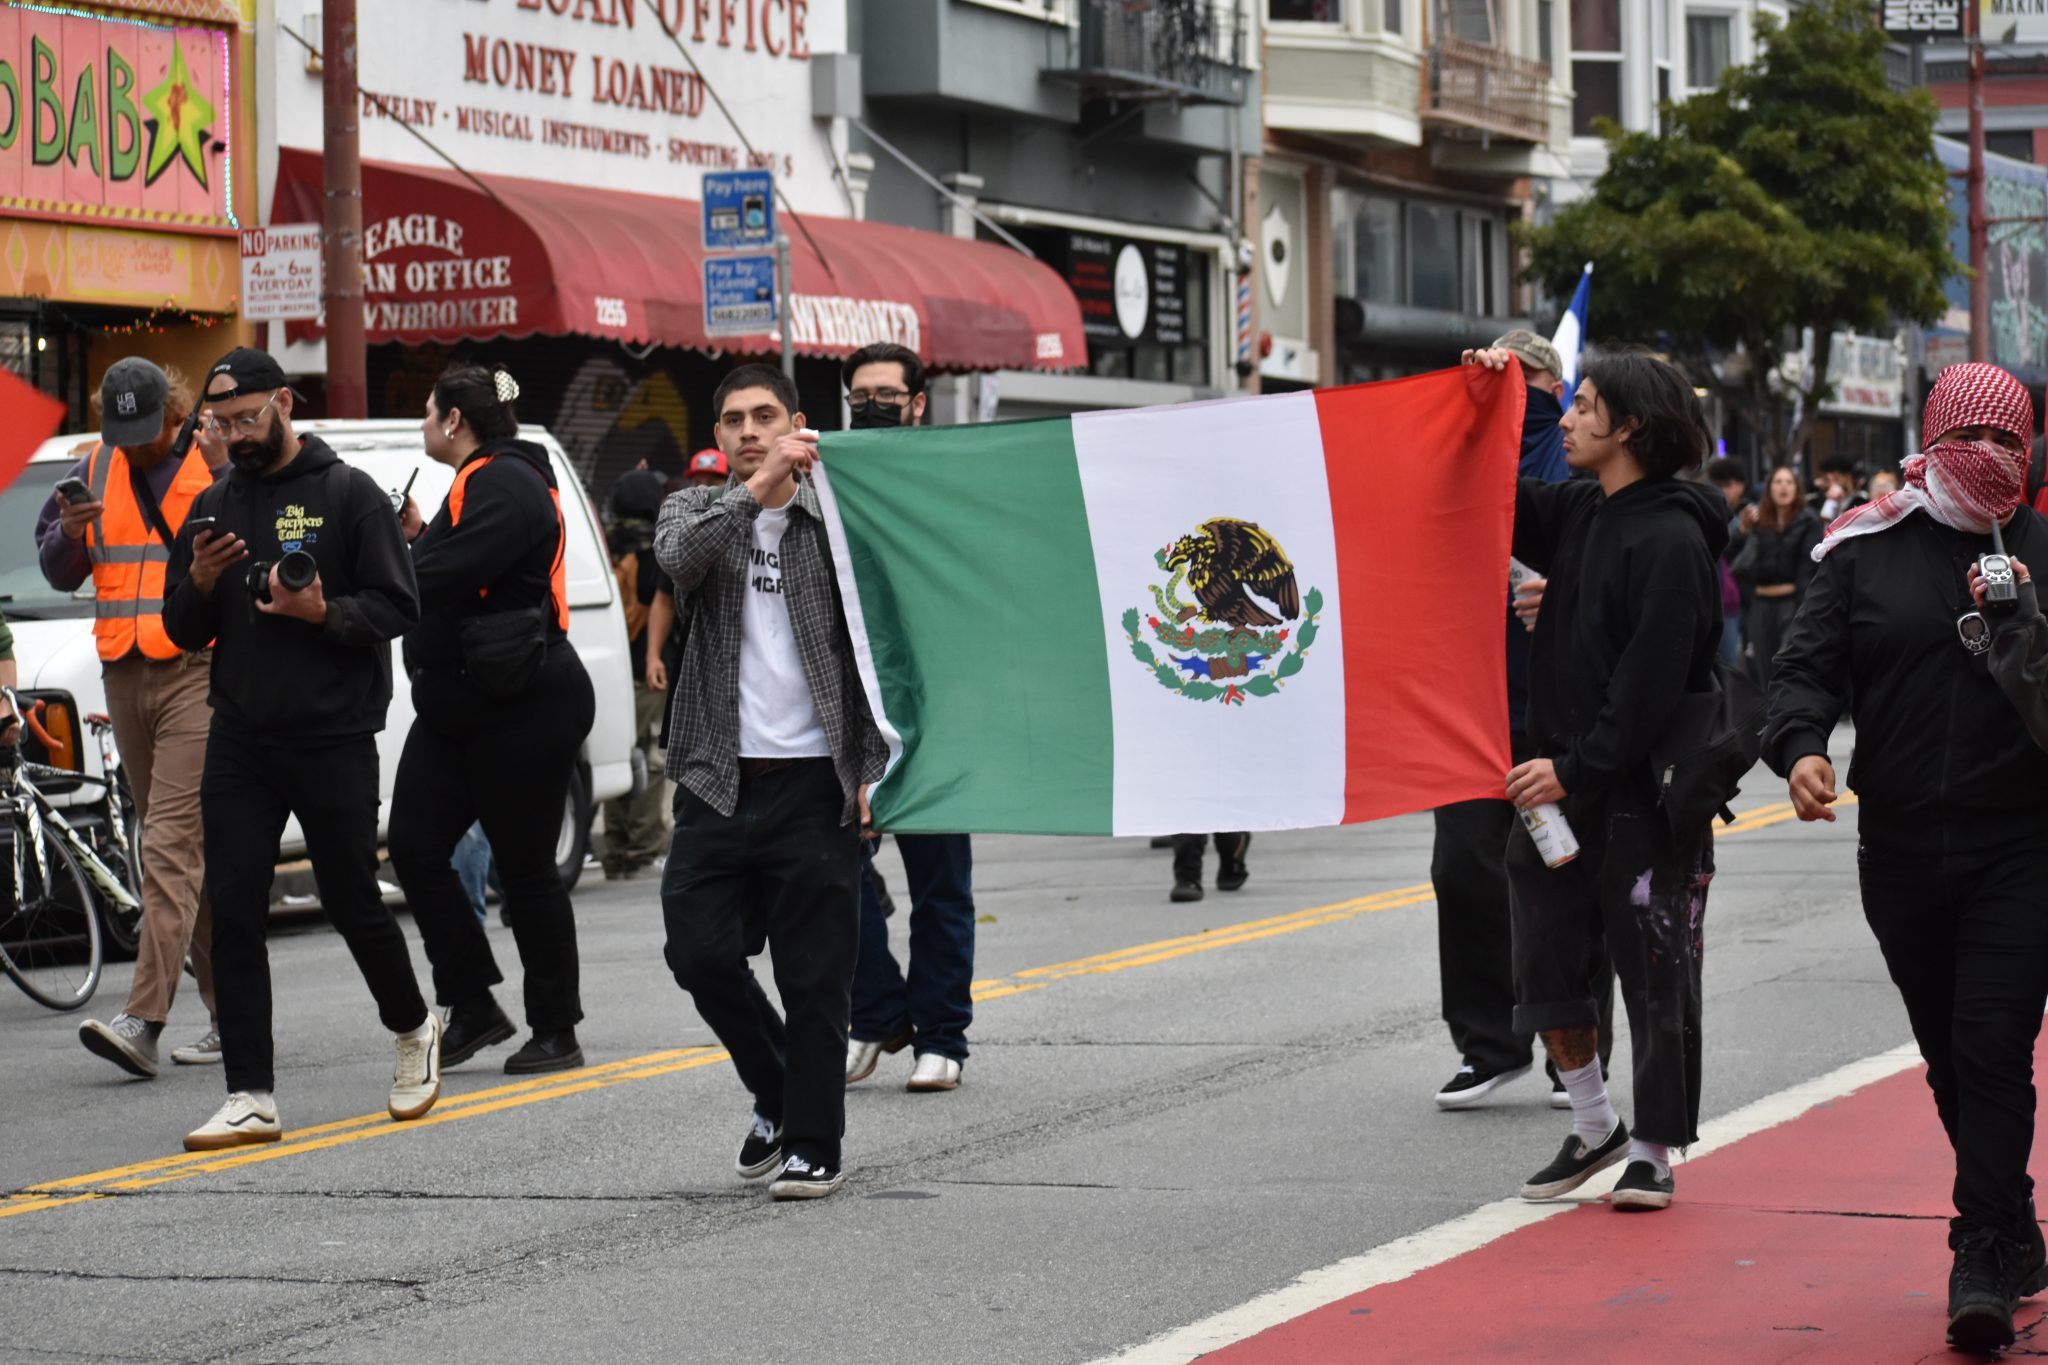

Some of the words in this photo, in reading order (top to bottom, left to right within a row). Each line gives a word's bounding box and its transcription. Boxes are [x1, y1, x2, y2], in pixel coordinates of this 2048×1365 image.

[1991, 0, 2048, 15] MAKIN
[463, 32, 576, 98] MONEY
[592, 56, 706, 118] LOANED
[362, 92, 437, 128] EWELRY
[456, 106, 534, 142] MUSICAL
[541, 119, 651, 158] INSTRUMENTS
[668, 138, 738, 169] SPORTING
[706, 179, 731, 198] Pay
[734, 175, 768, 193] here
[242, 230, 265, 256] NO
[267, 233, 319, 252] PARKING
[364, 213, 464, 259] EAGLE
[405, 256, 511, 293] OFFICE
[709, 264, 731, 281] Pay
[735, 261, 754, 278] by
[250, 278, 313, 292] EVERYDAY
[709, 277, 758, 291] License
[710, 291, 744, 305] Plate
[285, 504, 305, 520] Big
[275, 516, 324, 531] Steppers
[278, 528, 305, 541] Tour
